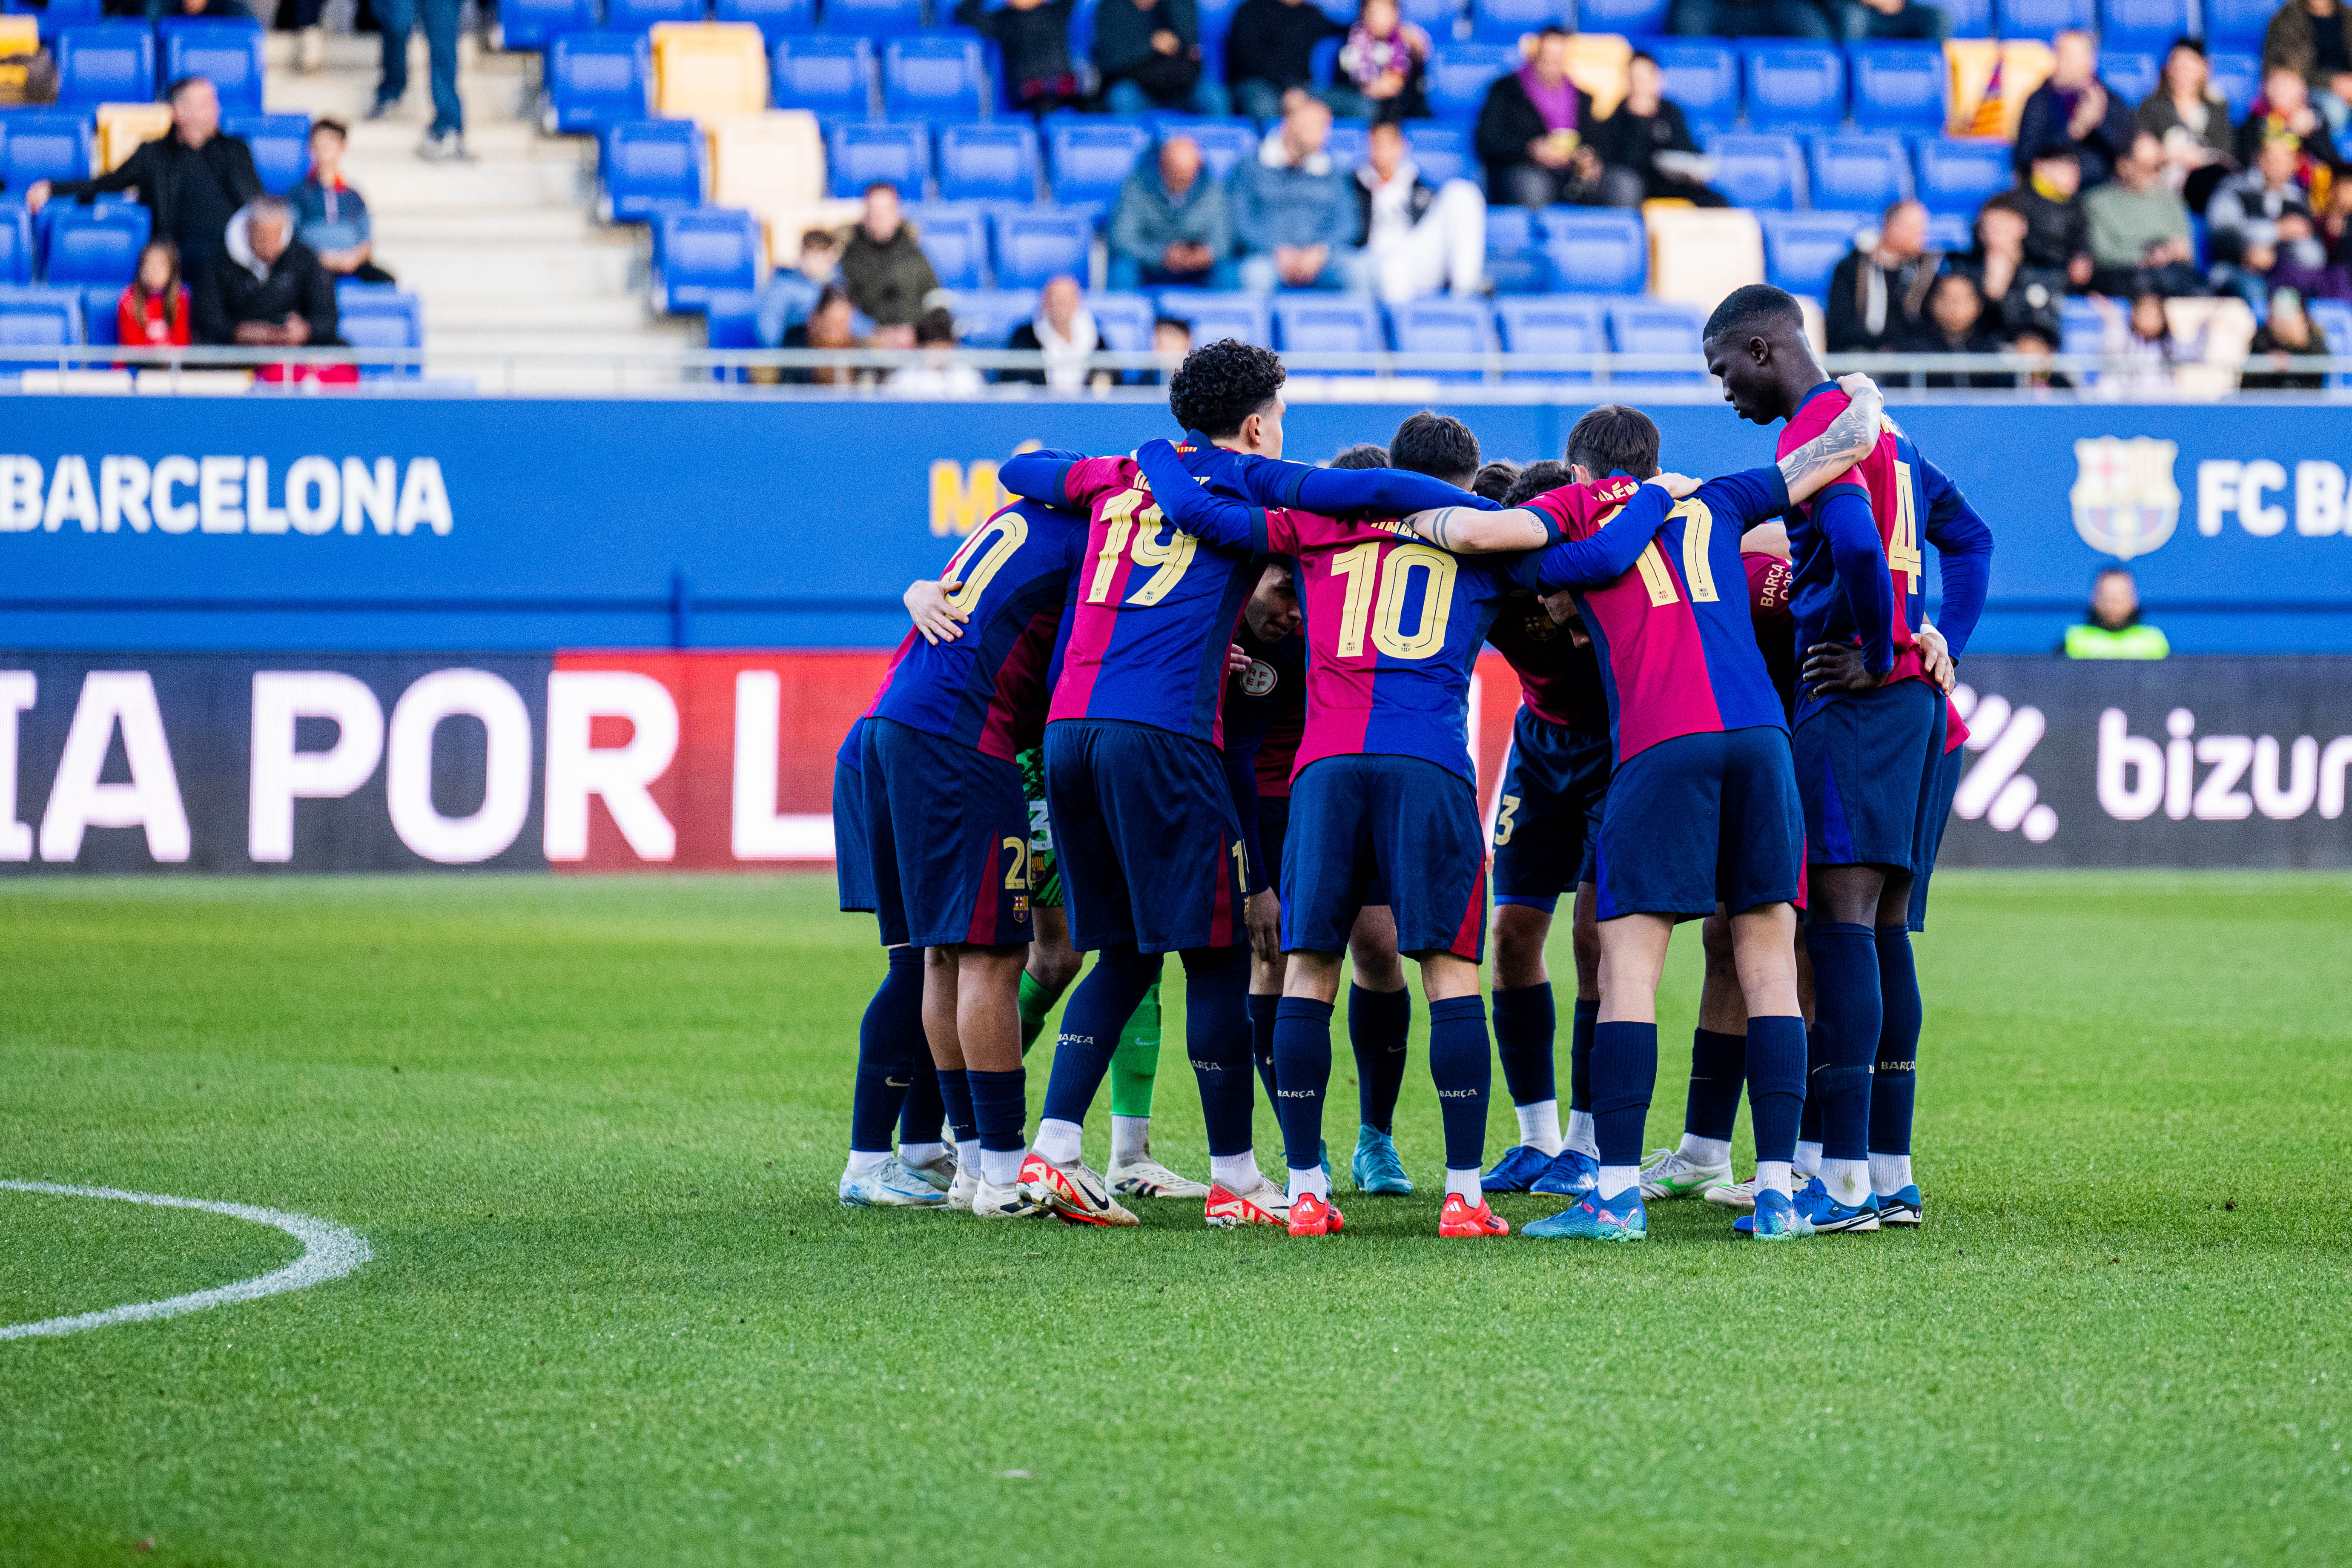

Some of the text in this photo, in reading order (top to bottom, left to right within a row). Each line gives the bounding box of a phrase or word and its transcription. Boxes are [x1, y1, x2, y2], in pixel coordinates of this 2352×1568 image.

[0, 454, 453, 535] BARCELONA
[1888, 459, 1922, 595] 4
[2197, 459, 2352, 537] FC B
[1086, 488, 1199, 606] 19
[1760, 564, 1785, 607] BARÇA
[1331, 542, 1458, 659] 10
[250, 668, 678, 863] POR
[1191, 1060, 1222, 1071] ARÇA
[1278, 1090, 1315, 1098] BARÇA
[1440, 1089, 1477, 1098] BARÇA
[1881, 1061, 1915, 1072] BARÇA
